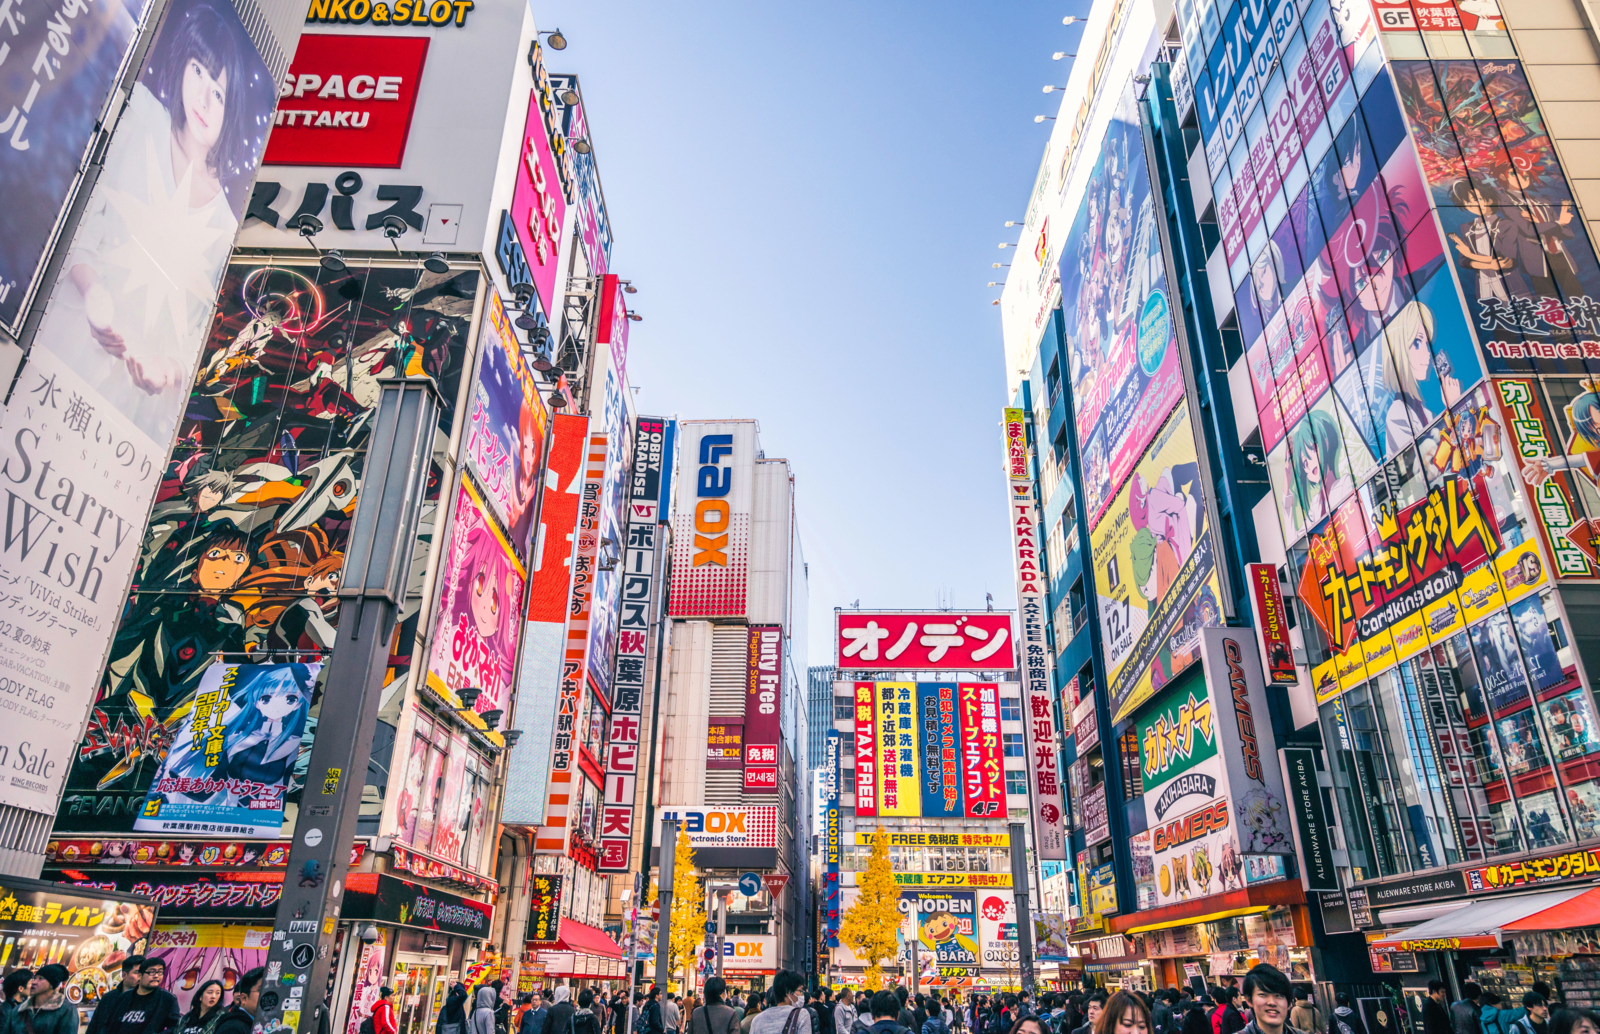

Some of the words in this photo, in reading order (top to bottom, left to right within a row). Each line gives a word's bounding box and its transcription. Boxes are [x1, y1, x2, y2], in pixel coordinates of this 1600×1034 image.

[1382, 10, 1412, 27] 6F
[1325, 62, 1342, 97] 6F
[30, 373, 152, 483] 水瀬いのり
[633, 421, 651, 496] PARADISE
[650, 422, 663, 473] HOBBY
[0, 427, 134, 563] Starry
[1500, 380, 1592, 578] カードゲム専門店
[3, 488, 105, 604] Wish
[1015, 505, 1039, 594] TAKARADA
[750, 631, 760, 667] Flagship
[759, 631, 780, 674] Duty
[842, 616, 1009, 663] オノデン
[25, 686, 55, 710] FLAG
[750, 669, 759, 695] Store
[759, 674, 779, 715] Free
[856, 687, 872, 722] 免税
[1222, 637, 1266, 787] GAMERS
[708, 726, 725, 736] 本店
[857, 724, 873, 758] TAX
[13, 740, 55, 780] Sale
[748, 747, 775, 761] 免税
[828, 736, 839, 801] Panasonic
[157, 777, 288, 800] 応援ありがとうフェア
[746, 771, 777, 783] 면세점
[858, 762, 874, 809] FREE
[971, 801, 998, 815] 4F
[726, 835, 748, 843] Store
[828, 808, 838, 864] ONODEN
[891, 834, 926, 845] FREE
[1153, 800, 1229, 854] GAMERS
[927, 874, 965, 884] エアコン
[1376, 886, 1411, 899] ALIENWARE
[1412, 882, 1434, 894] STORE
[1434, 880, 1456, 891] AKIBA
[290, 921, 318, 933] DAVE
